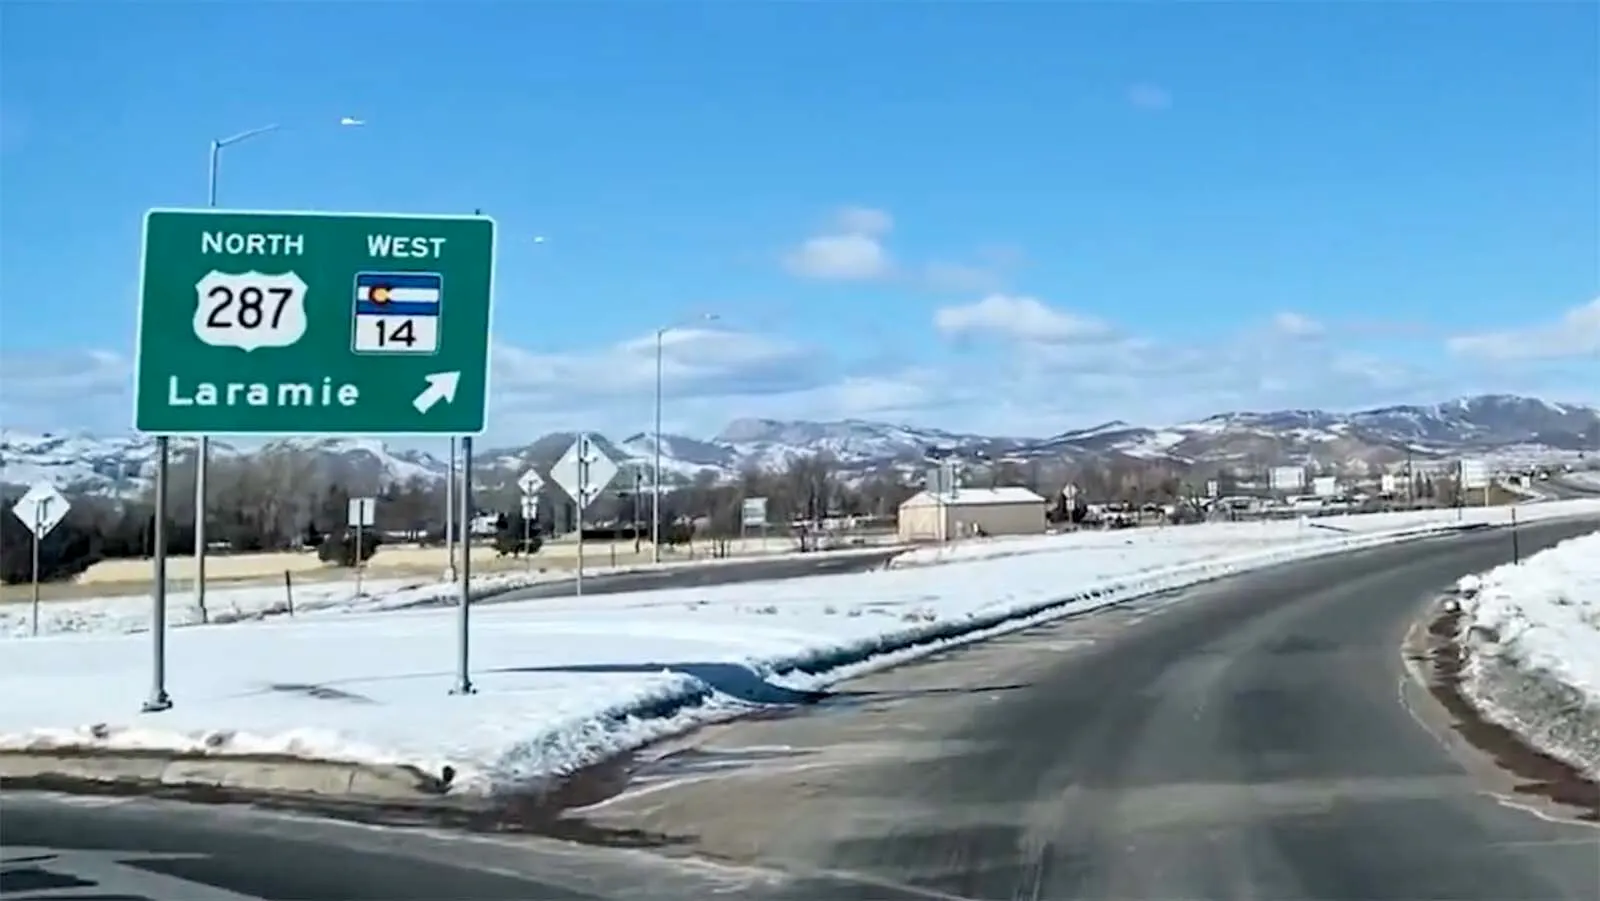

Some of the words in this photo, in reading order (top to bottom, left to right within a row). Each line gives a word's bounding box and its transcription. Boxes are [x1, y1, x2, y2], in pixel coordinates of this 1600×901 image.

[201, 231, 304, 256] NORTH
[367, 234, 447, 258] WEST
[206, 286, 294, 330] 287
[374, 319, 417, 347] 14
[168, 375, 360, 407] Laramie
